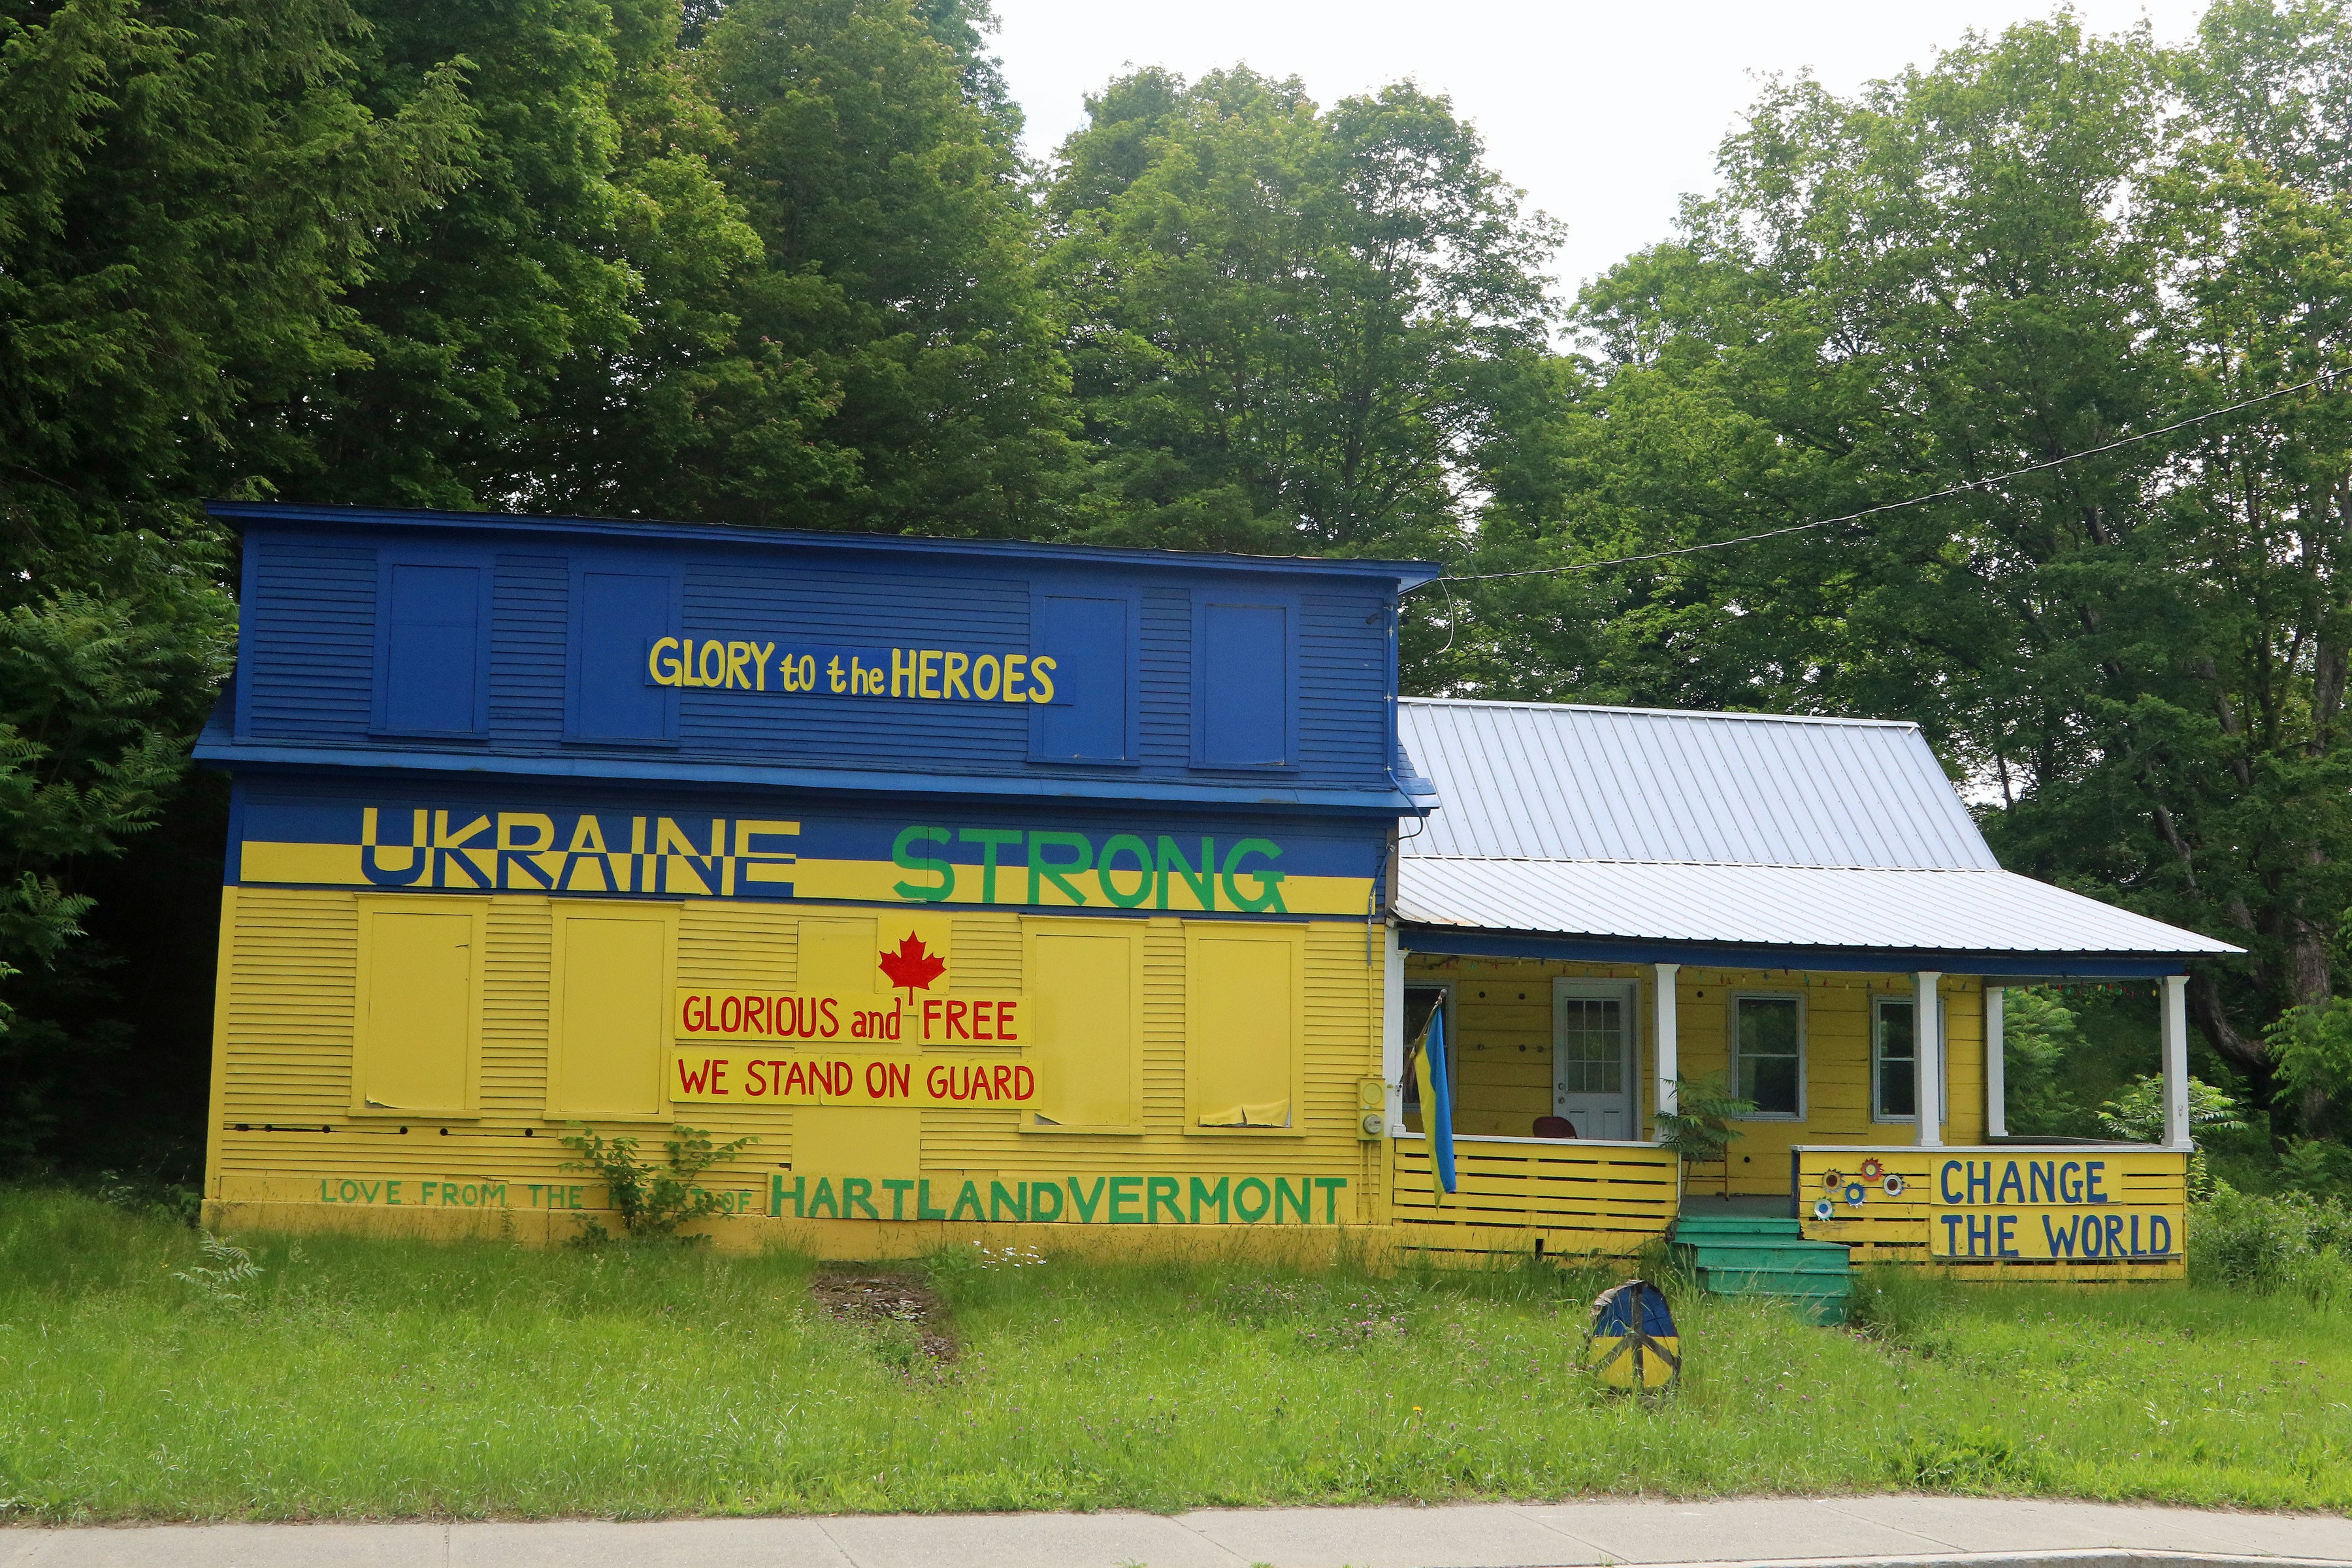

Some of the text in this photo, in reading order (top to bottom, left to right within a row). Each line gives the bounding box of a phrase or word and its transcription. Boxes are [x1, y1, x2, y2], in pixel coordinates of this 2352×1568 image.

[649, 636, 1057, 704] GLORY to the HEROES
[361, 807, 1288, 913] UKRAINE STRONG
[683, 996, 1017, 1040] GLORIOUS and FREE
[678, 1058, 1035, 1101] WE STAND ON GUARD
[321, 1179, 402, 1205] LOVE
[421, 1182, 506, 1207] FROM
[528, 1184, 583, 1210] THE
[721, 1190, 753, 1213] OF
[1941, 1160, 2108, 1204] CHANGE
[1941, 1215, 2172, 1258] THE WORLD
